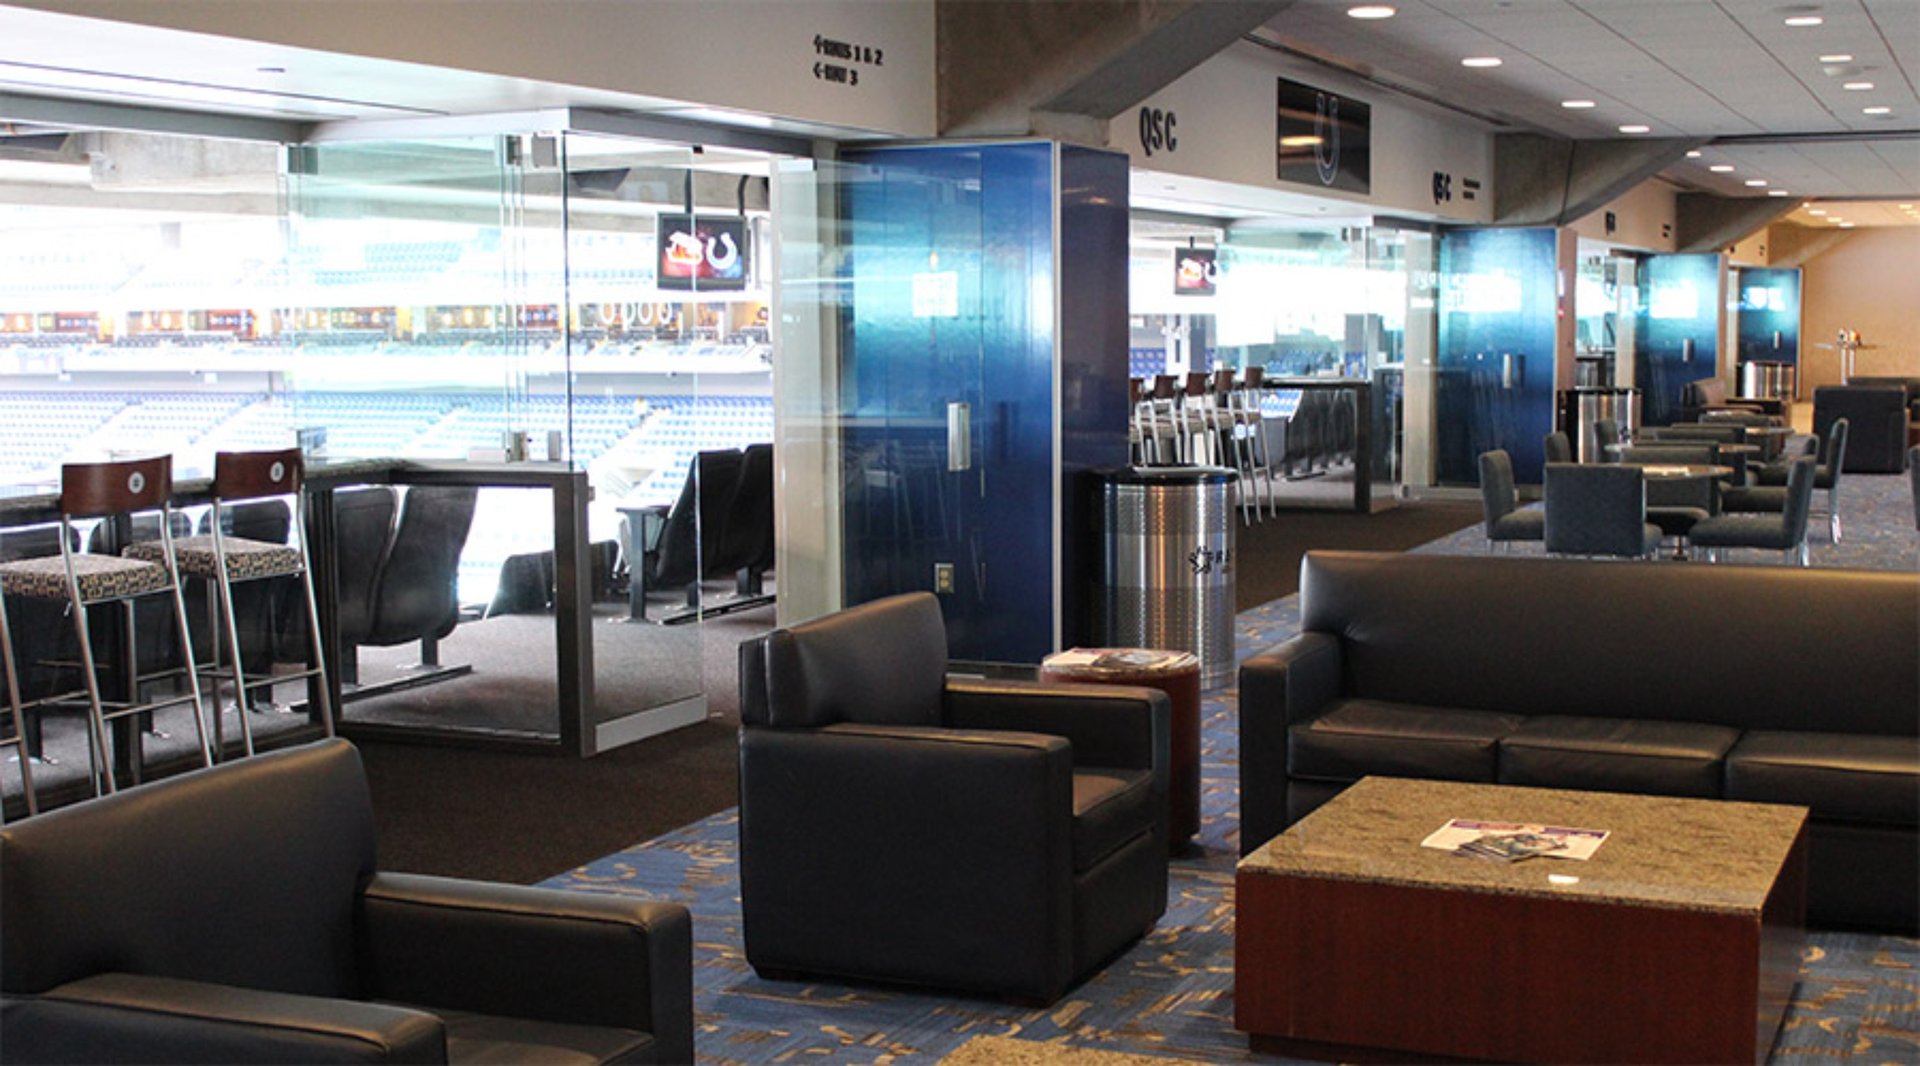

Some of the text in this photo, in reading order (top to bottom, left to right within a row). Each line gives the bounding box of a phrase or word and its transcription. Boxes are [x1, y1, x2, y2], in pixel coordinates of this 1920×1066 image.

[855, 45, 860, 62] 1
[875, 49, 883, 66] 2
[850, 69, 858, 86] 3
[1139, 106, 1177, 157] QSC
